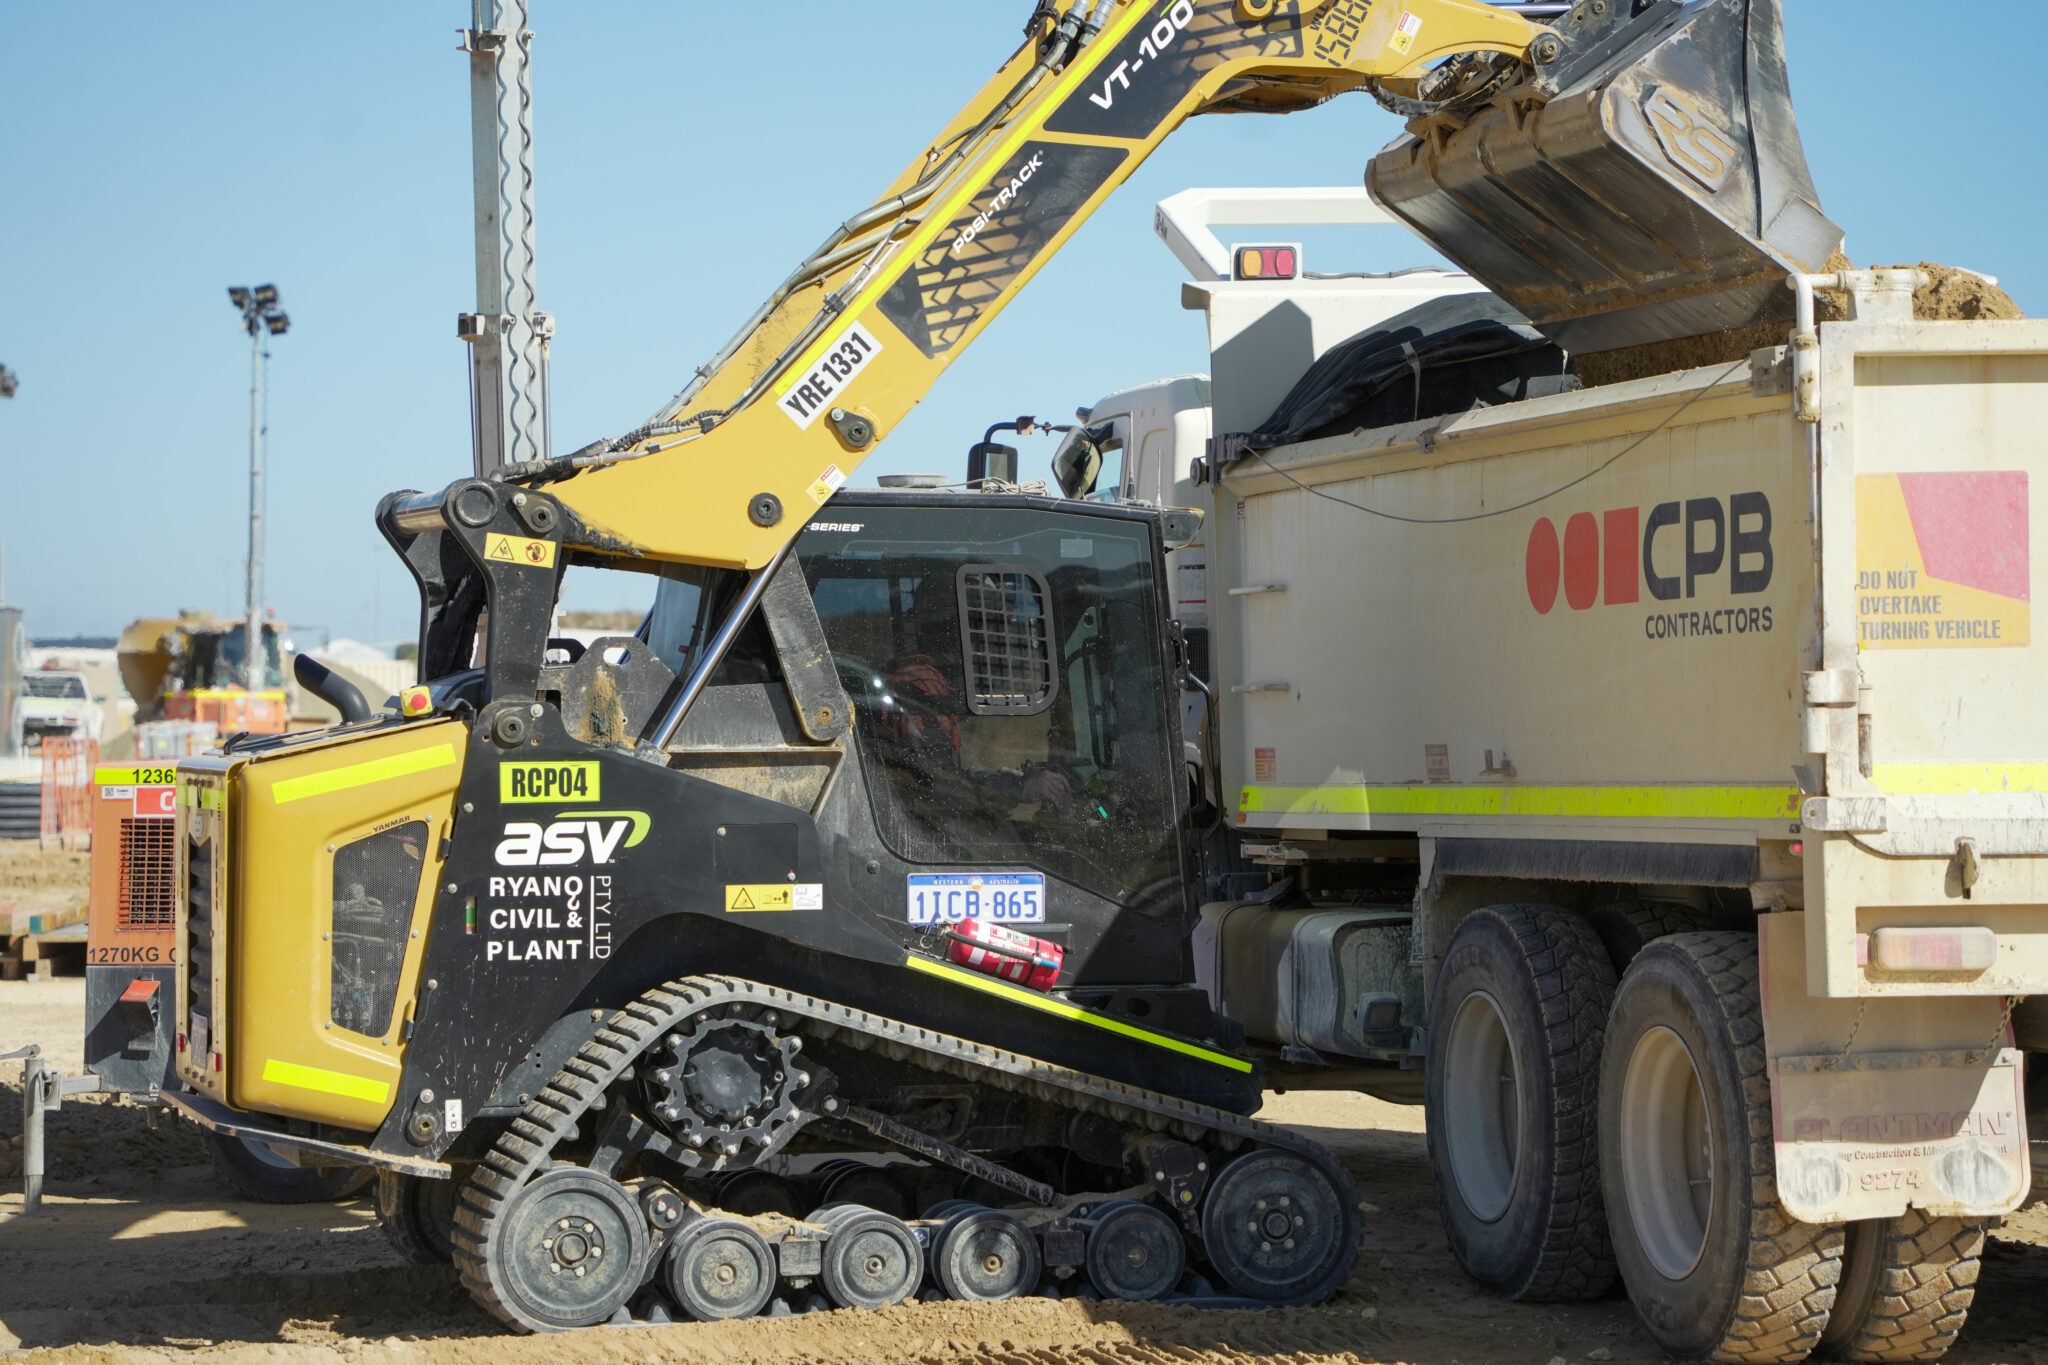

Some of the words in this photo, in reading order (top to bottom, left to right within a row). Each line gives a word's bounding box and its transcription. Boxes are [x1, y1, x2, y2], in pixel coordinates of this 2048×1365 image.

[1089, 0, 1193, 110] VT-100
[952, 153, 1043, 254] POSI-TRACK
[786, 372, 834, 419] YRE
[821, 331, 873, 384] 1331
[803, 522, 861, 532] -SERIES
[1643, 491, 1774, 601] CPB
[1859, 571, 1881, 590] DO
[1886, 570, 1918, 590] NOT
[1860, 595, 1942, 615] OVERTAKE
[1645, 605, 1773, 639] CONTRACTORS
[1859, 620, 1930, 641] TURNING
[1934, 619, 2001, 640] VEHICLE
[132, 769, 176, 784] 1236
[373, 815, 411, 832] YANMAR
[595, 875, 612, 915] PTY
[490, 908, 561, 929] CIVIL
[566, 911, 583, 929] &
[487, 939, 583, 962] PLANT
[595, 922, 612, 959] LTD
[89, 946, 160, 963] 1270KG
